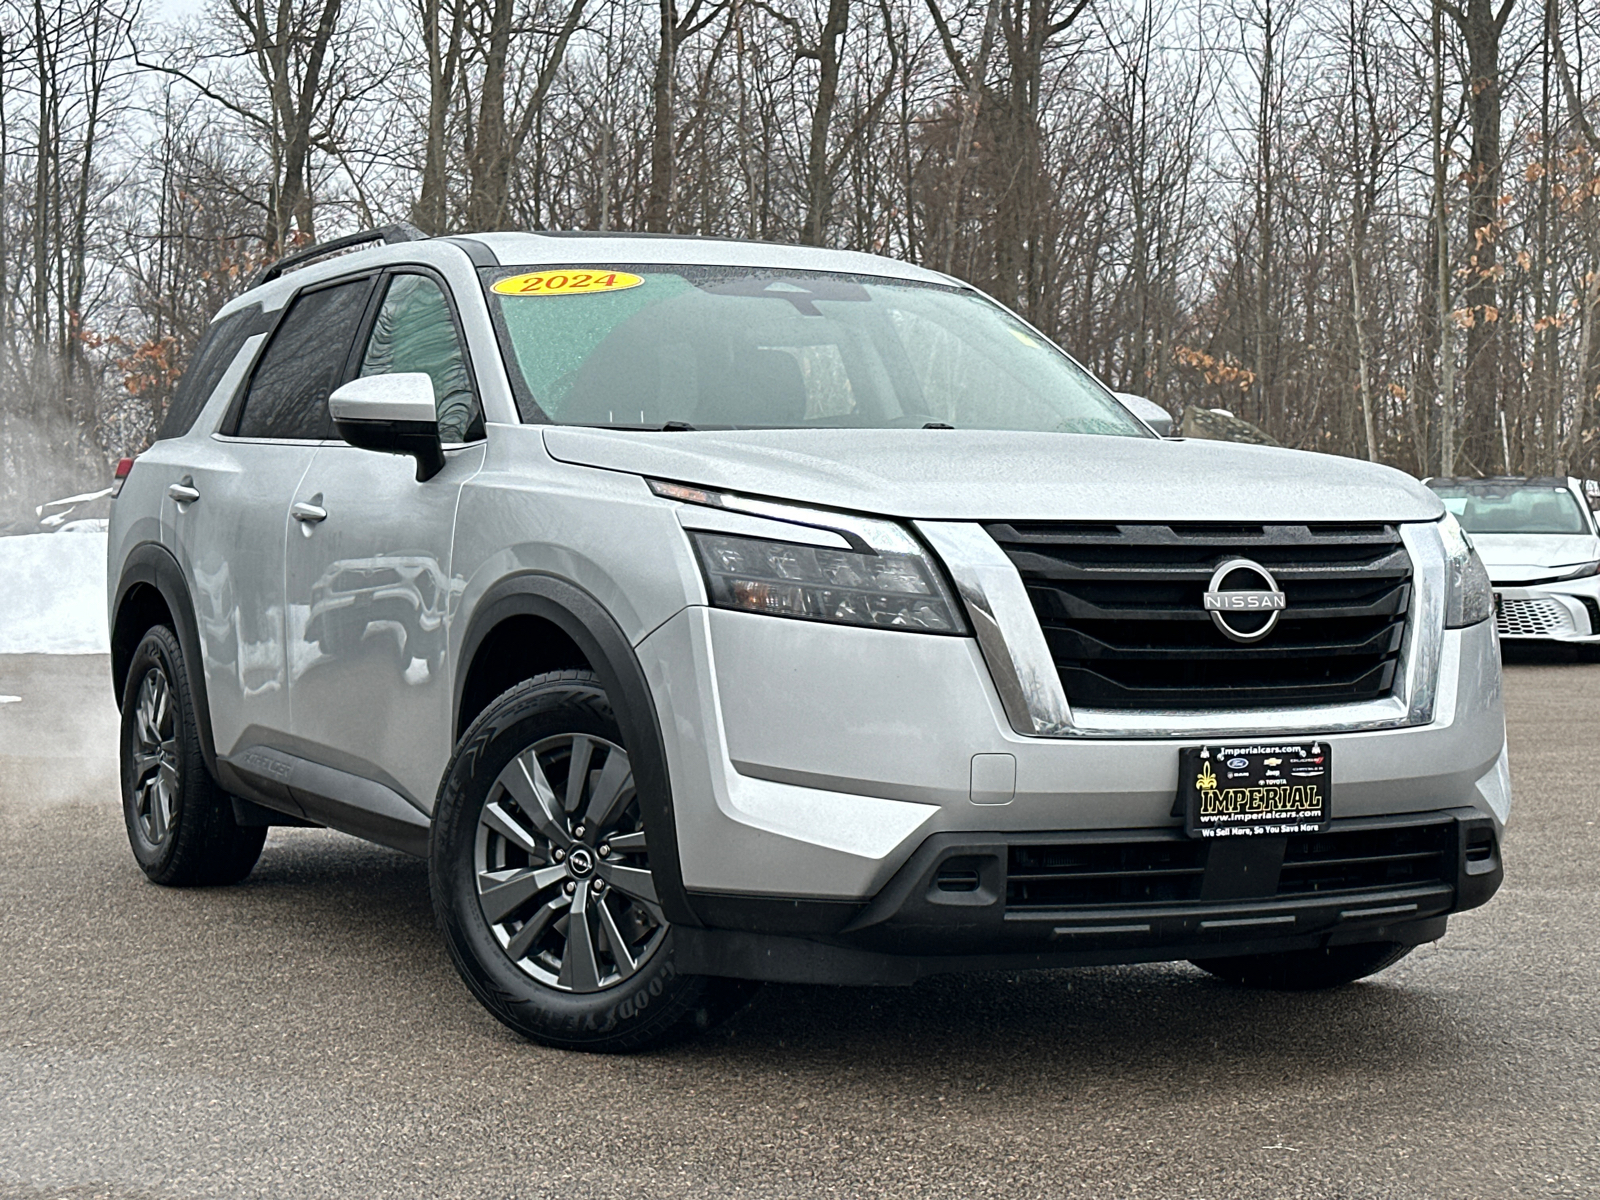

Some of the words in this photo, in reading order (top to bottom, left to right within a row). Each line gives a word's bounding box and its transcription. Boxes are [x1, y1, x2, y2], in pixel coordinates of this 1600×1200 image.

[520, 274, 618, 292] 2024
[1206, 596, 1285, 608] NISSAN
[1220, 746, 1301, 756] Imperialcars.com
[1201, 785, 1322, 814] IMPERIAL
[1200, 810, 1321, 822] www.imperialcars.com
[1202, 828, 1214, 837] We
[1215, 827, 1229, 836] Sell
[1254, 826, 1264, 834] So
[1265, 825, 1280, 834] You
[1281, 823, 1299, 833] Save
